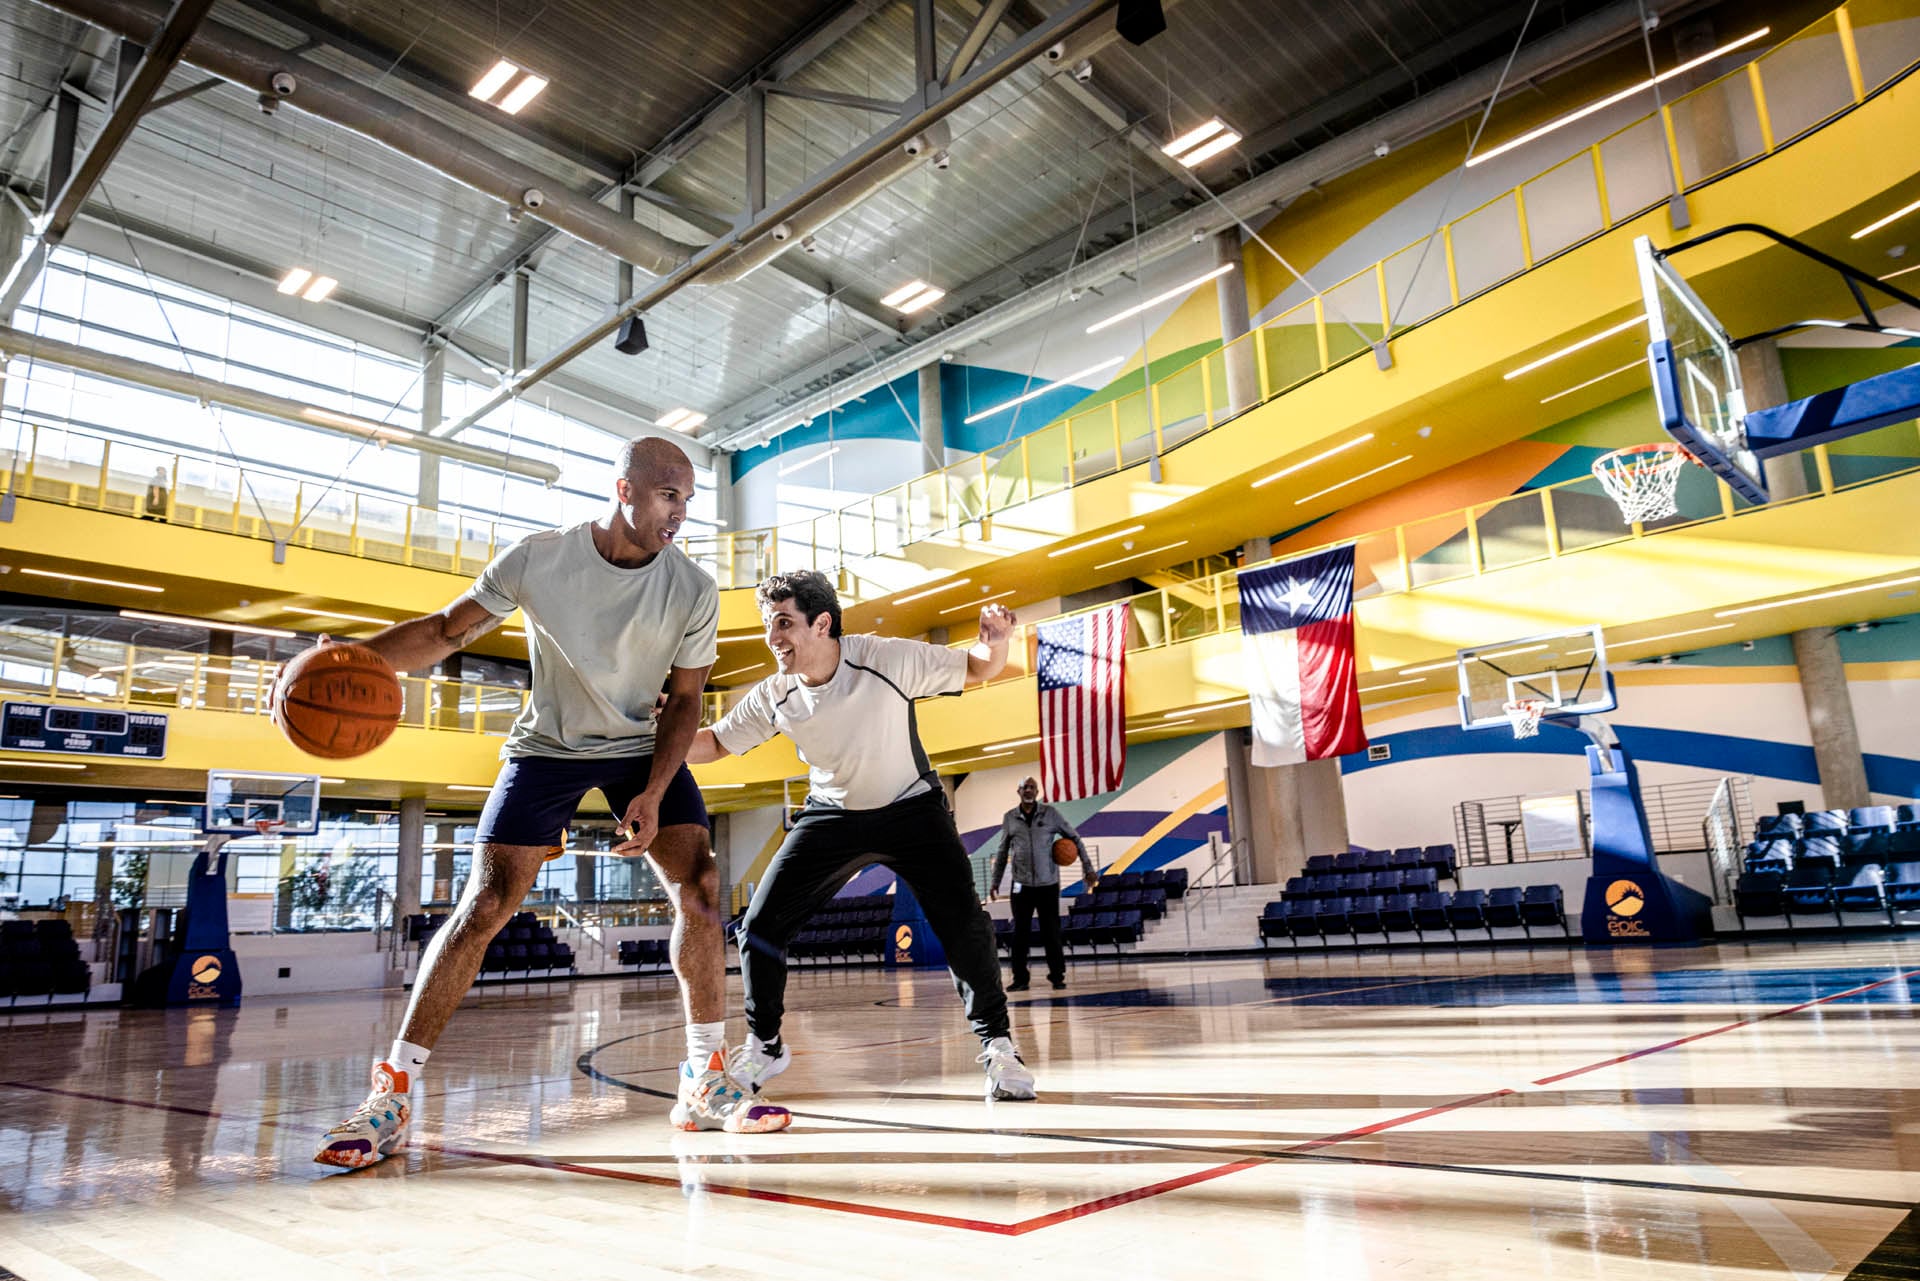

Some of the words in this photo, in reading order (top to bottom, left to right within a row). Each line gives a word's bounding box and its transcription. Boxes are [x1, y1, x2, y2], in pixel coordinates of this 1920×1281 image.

[10, 705, 42, 716] HOME
[130, 715, 166, 726] VISITOR
[19, 739, 46, 748] BONUS
[64, 738, 92, 746] PERIOD
[123, 746, 148, 754] BONUS
